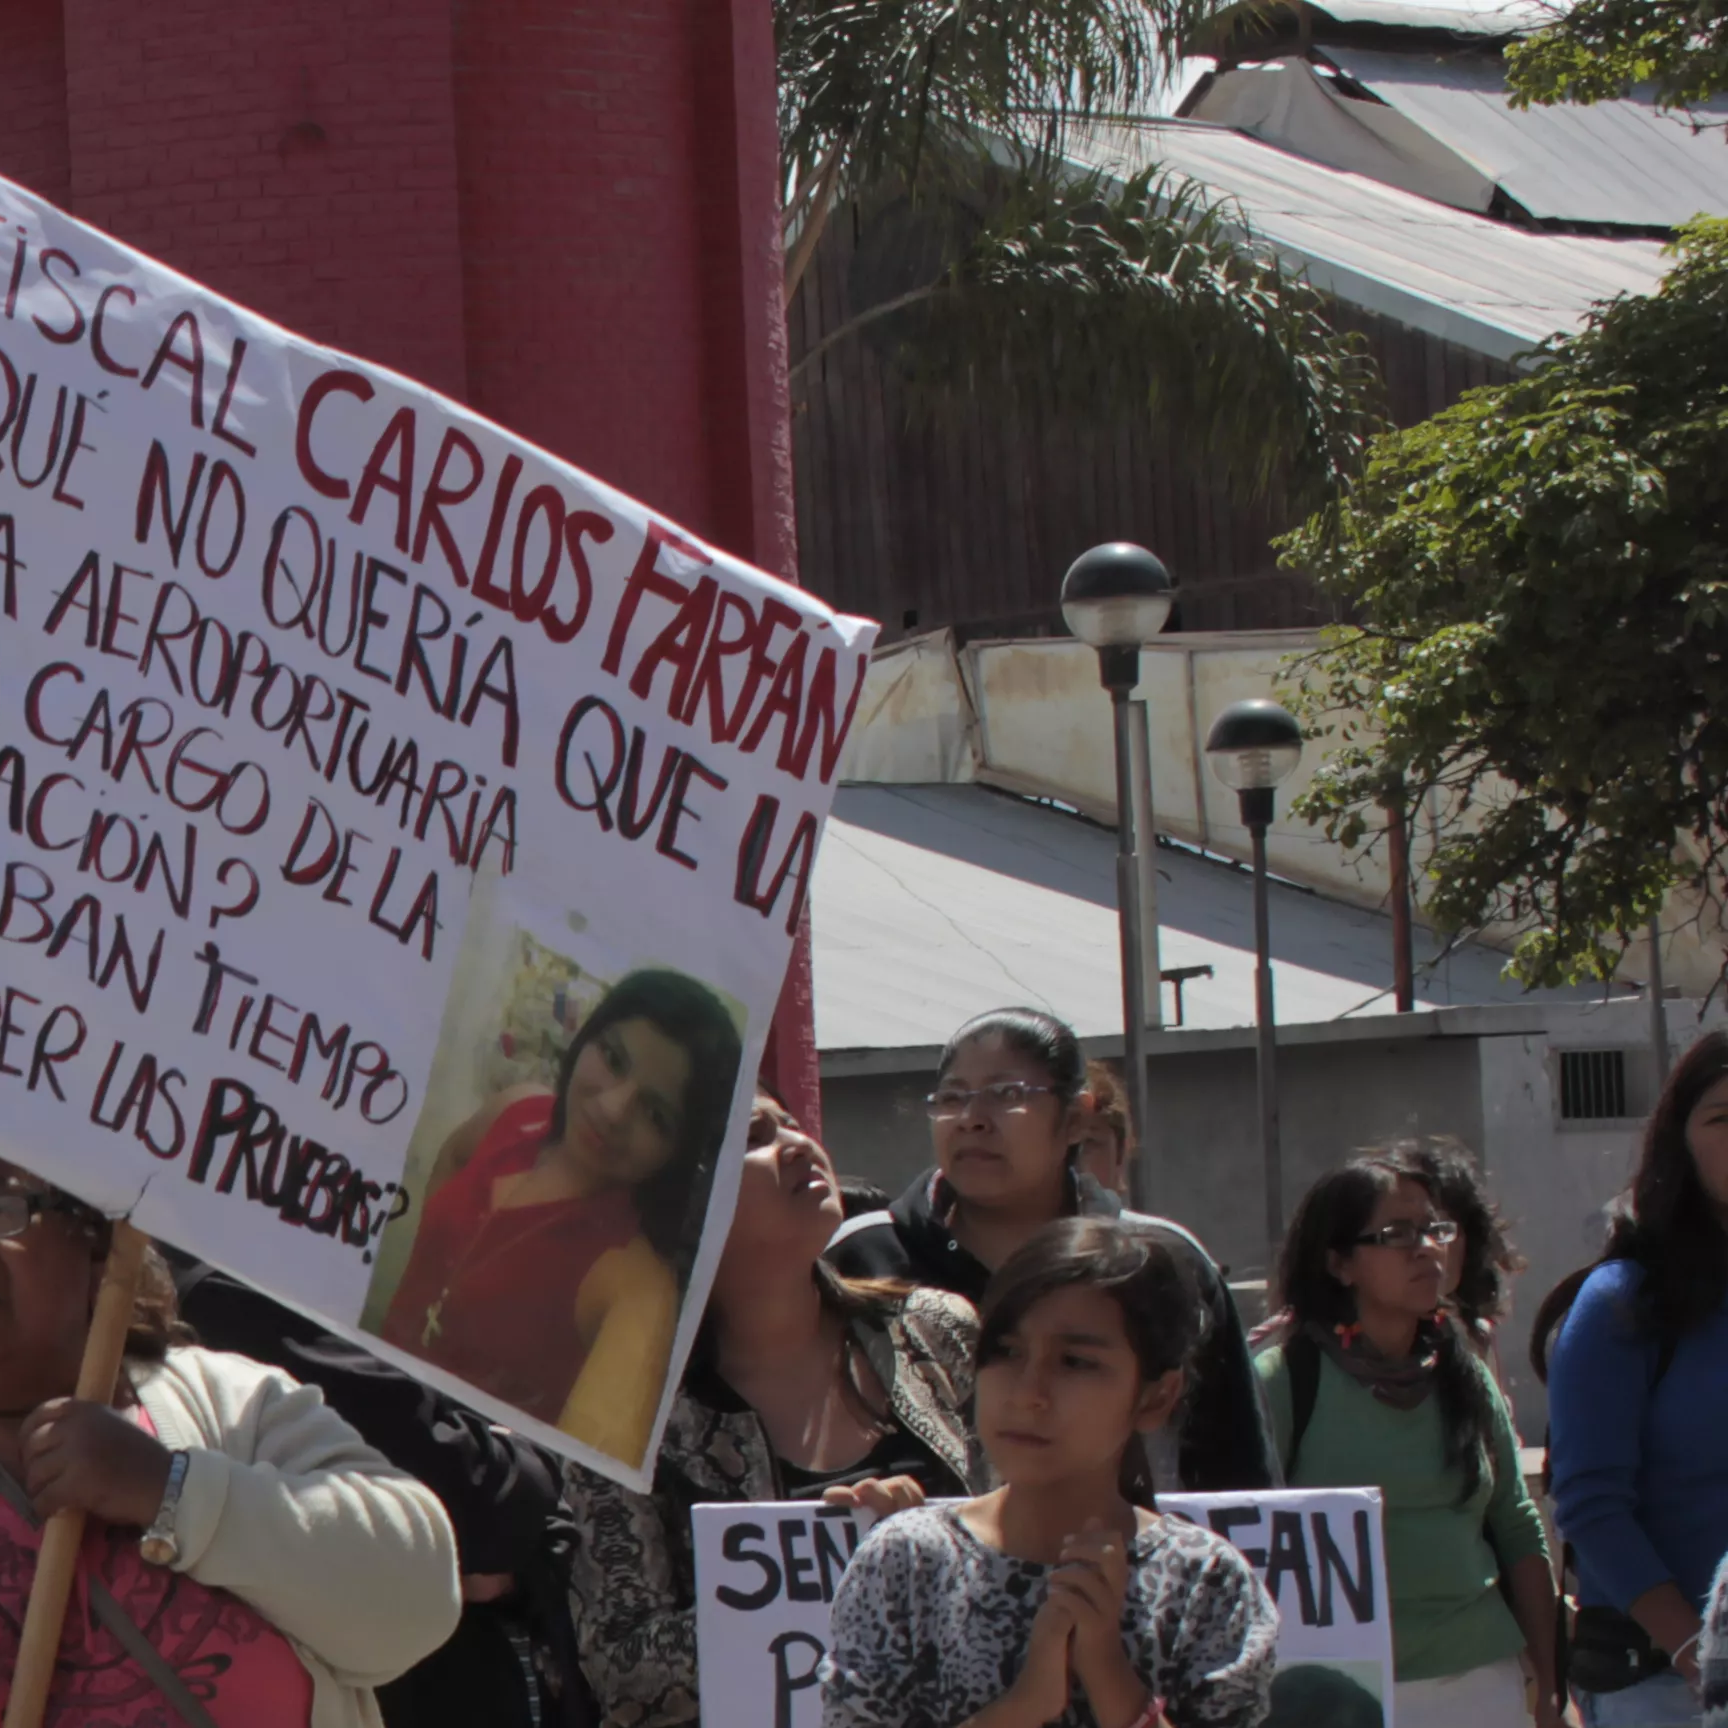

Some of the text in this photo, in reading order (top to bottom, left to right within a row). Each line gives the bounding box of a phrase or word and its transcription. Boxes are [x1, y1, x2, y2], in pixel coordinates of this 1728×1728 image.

[295, 370, 614, 643] CARLOS
[25, 661, 270, 835] CARGO
[280, 797, 373, 906] DE
[369, 846, 442, 961] LA
[136, 440, 246, 578] NO
[554, 695, 728, 871] QUE
[734, 795, 816, 936] LA
[90, 1040, 187, 1160] LAS
[716, 1506, 1374, 1627] SEÑ FAN
